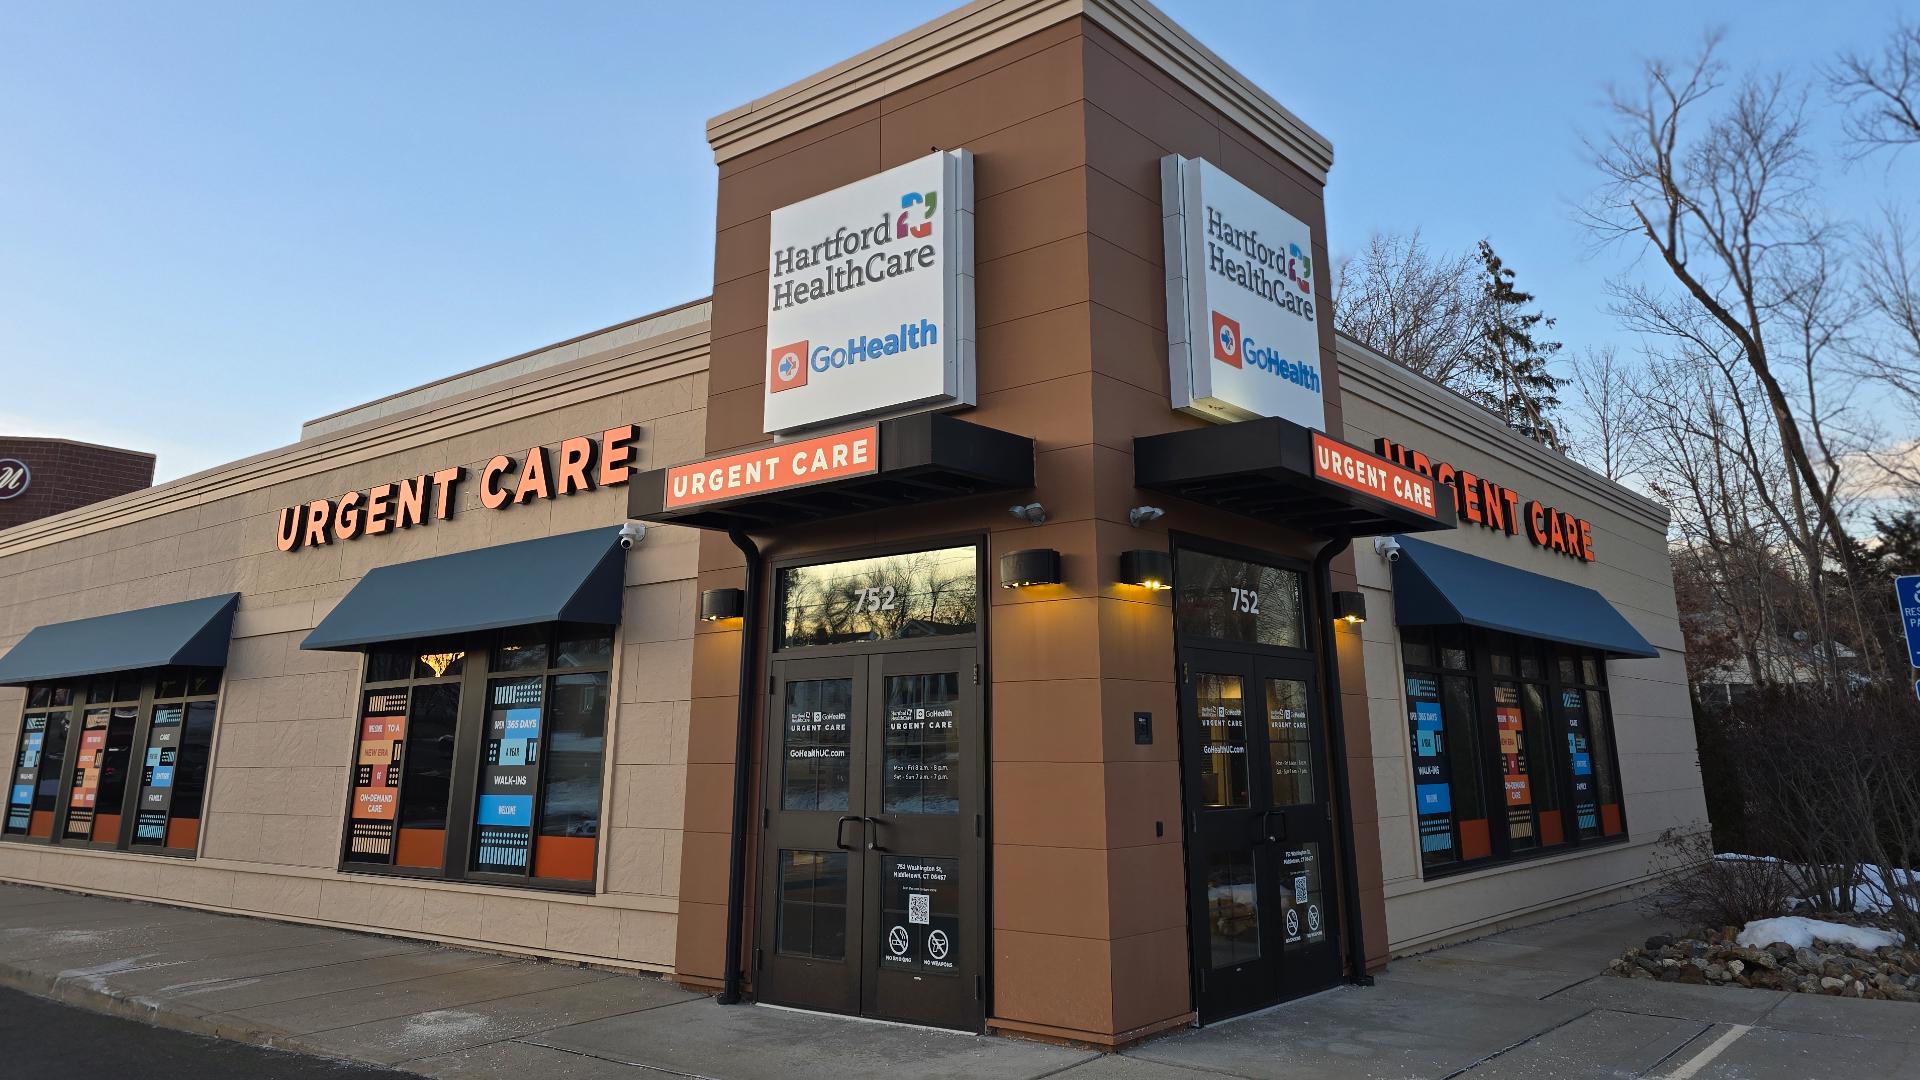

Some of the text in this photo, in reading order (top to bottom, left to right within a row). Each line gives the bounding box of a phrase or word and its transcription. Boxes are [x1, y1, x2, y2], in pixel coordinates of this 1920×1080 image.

[773, 212, 893, 278] Hartford
[1206, 206, 1288, 277] Hartford
[772, 244, 936, 312] HealthCare
[1208, 241, 1314, 322] HealthCare
[810, 318, 938, 373] GoHealth
[1242, 337, 1320, 393] GoHealth
[276, 424, 641, 552] URGENT CARE
[673, 439, 868, 498] URGENT CARE
[1318, 445, 1432, 508] URGENT CARE
[1524, 499, 1595, 562] CARE
[853, 586, 895, 613] 752
[1231, 587, 1260, 614] 752
[507, 719, 520, 729] 365
[520, 719, 537, 729] DAYS
[890, 721, 953, 730] URGENT CARE
[925, 709, 953, 717] GoHealth
[494, 776, 527, 786] WALK-INS
[790, 749, 845, 757] GoHealthUC.com
